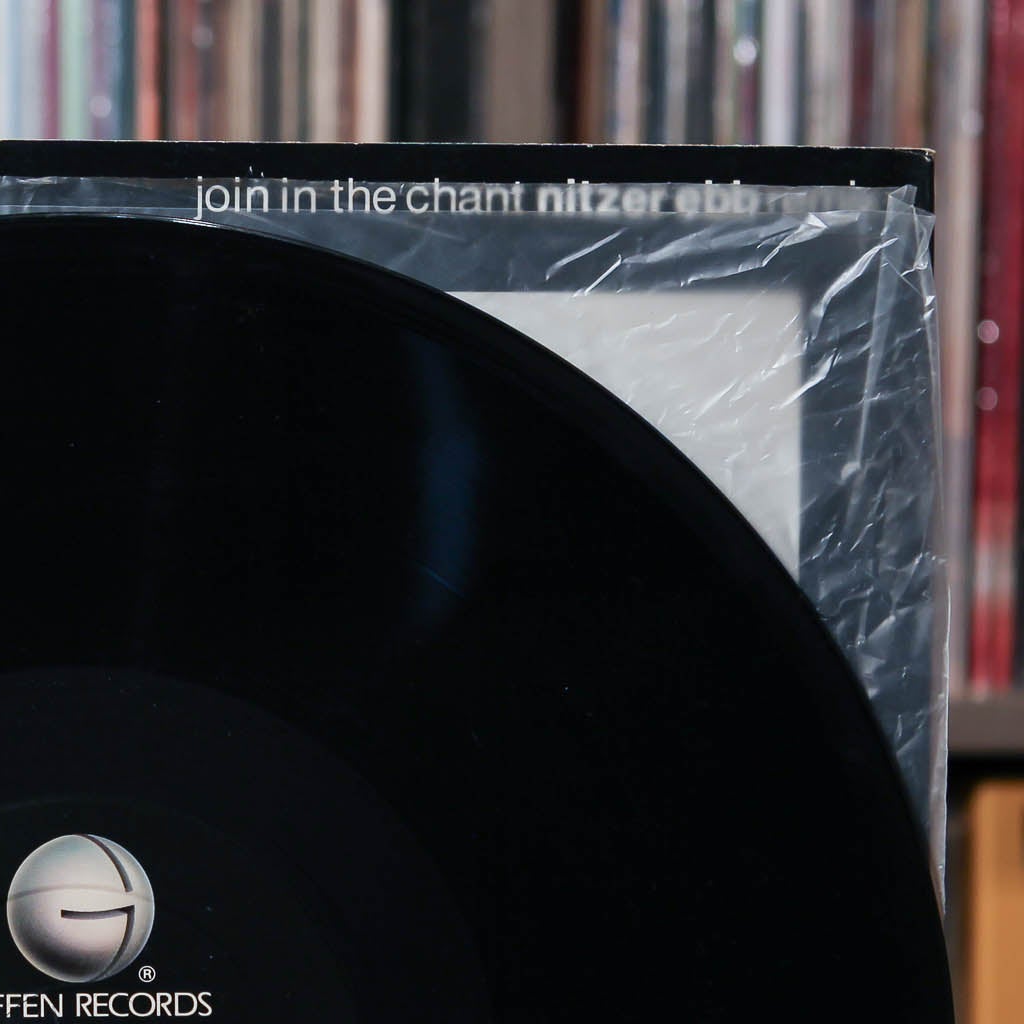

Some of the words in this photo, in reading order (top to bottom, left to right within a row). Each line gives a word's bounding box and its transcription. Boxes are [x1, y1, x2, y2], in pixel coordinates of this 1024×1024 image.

[193, 175, 269, 220] join
[281, 177, 317, 213] in
[330, 177, 397, 214] the
[406, 177, 525, 215] chant
[536, 178, 669, 216] nitzer
[76, 992, 213, 1018] RECORDS
